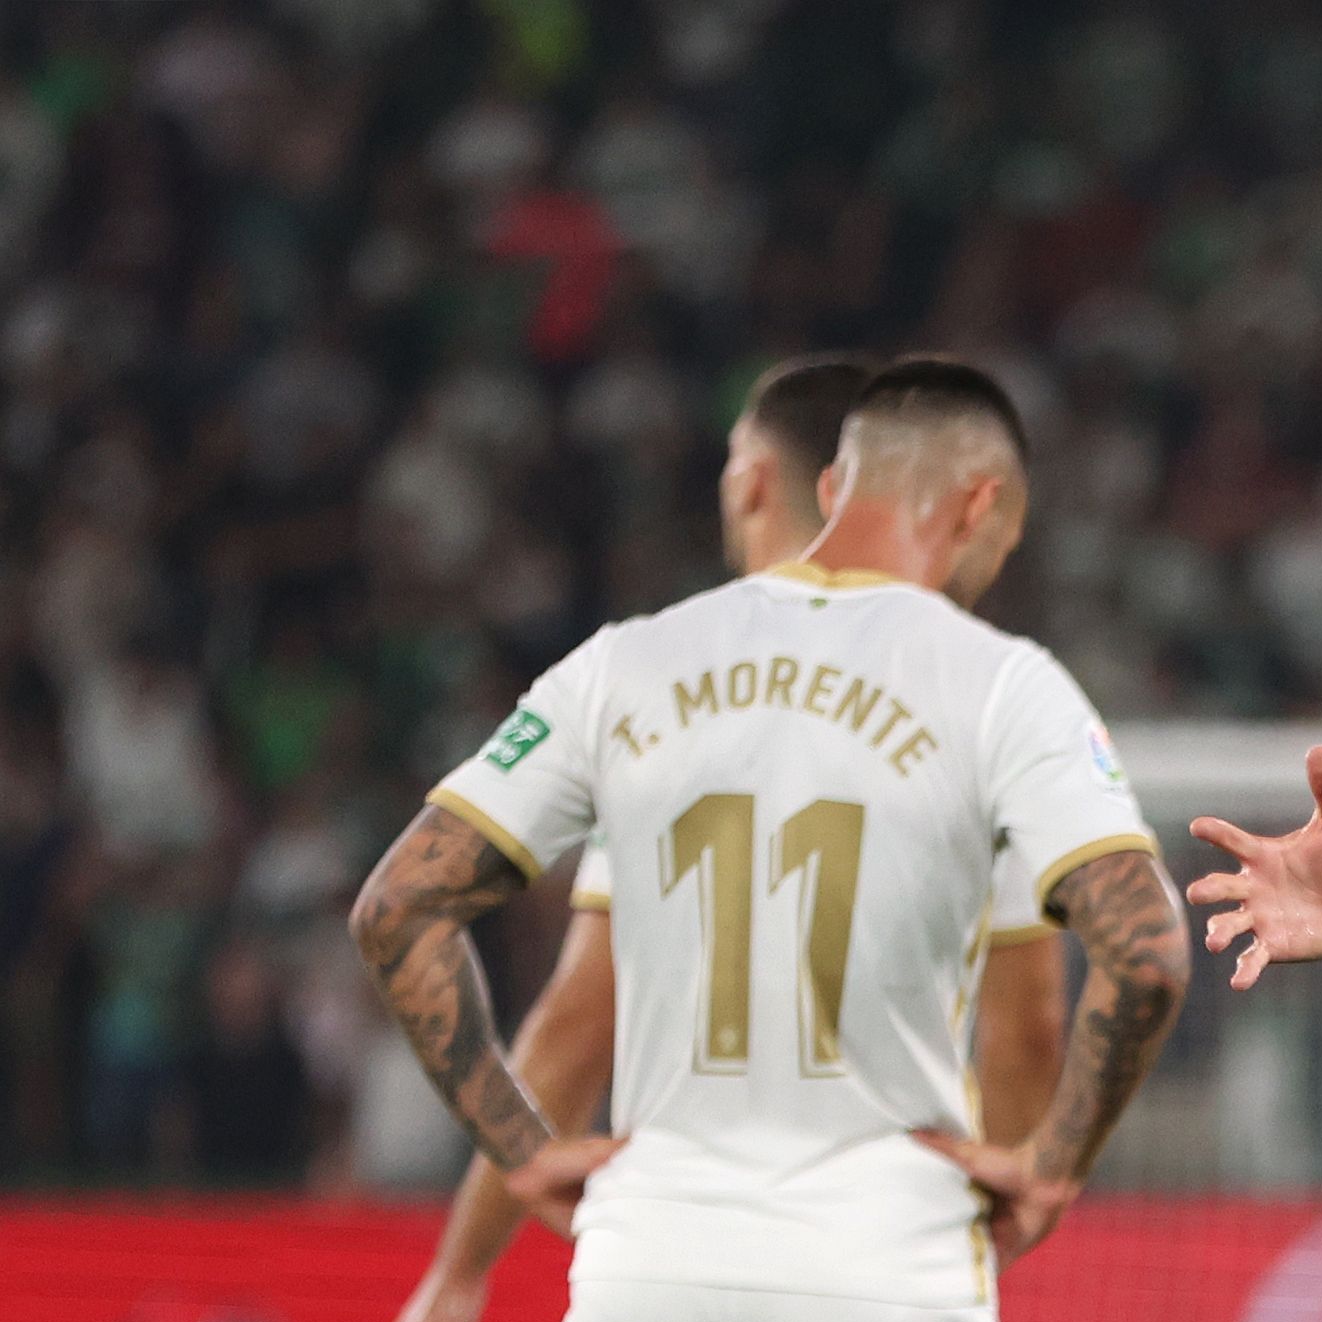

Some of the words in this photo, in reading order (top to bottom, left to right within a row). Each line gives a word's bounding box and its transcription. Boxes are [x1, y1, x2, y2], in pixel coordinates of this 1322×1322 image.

[611, 714, 659, 759] T.
[672, 656, 938, 778] MORENTE
[657, 793, 866, 1080] 11
